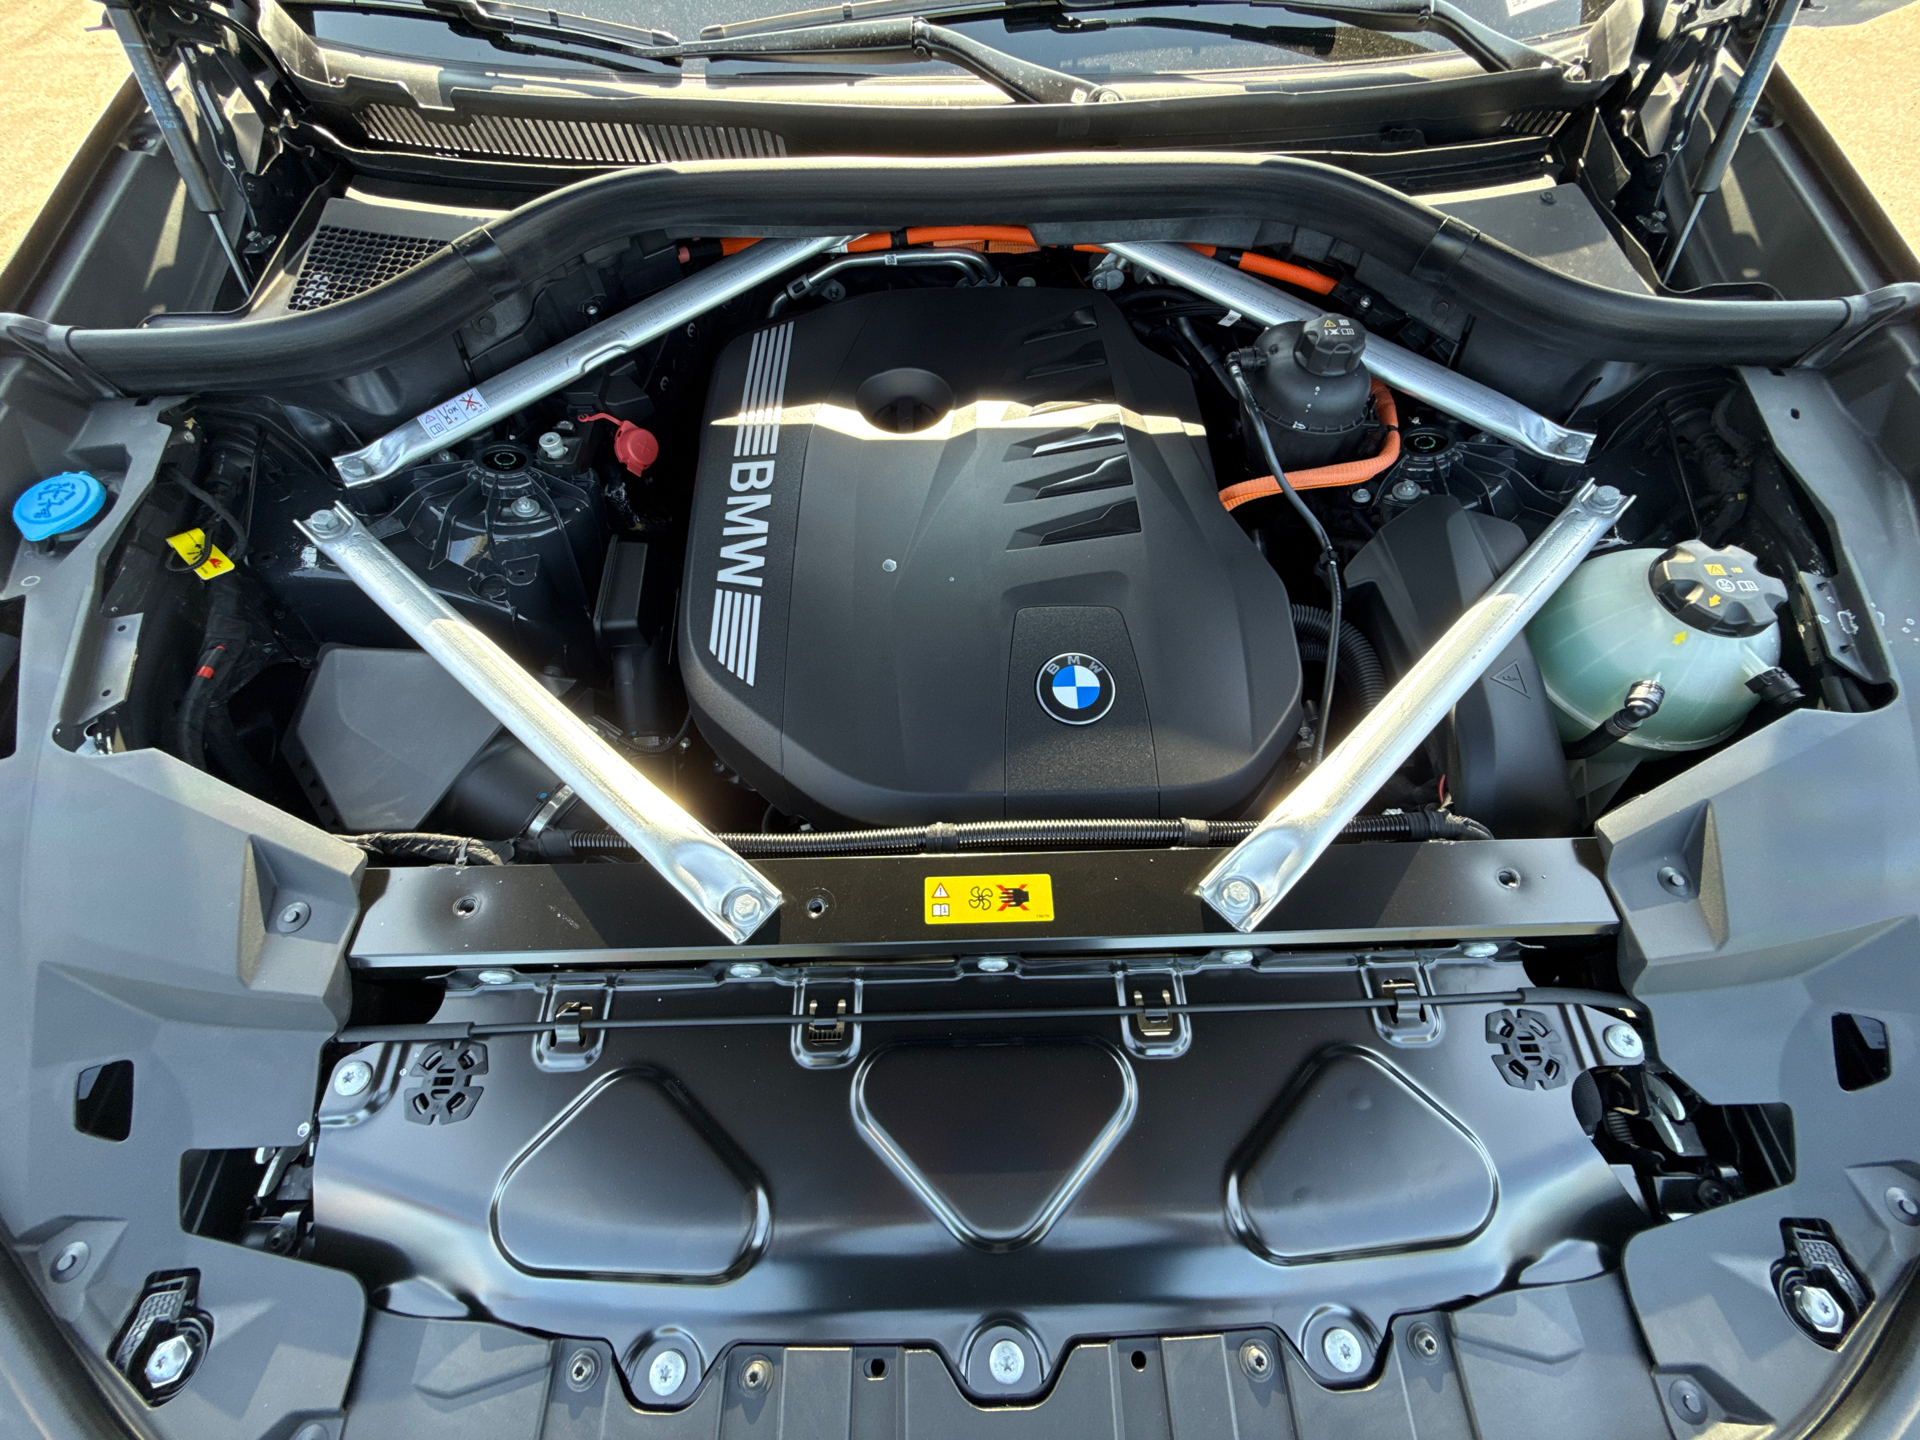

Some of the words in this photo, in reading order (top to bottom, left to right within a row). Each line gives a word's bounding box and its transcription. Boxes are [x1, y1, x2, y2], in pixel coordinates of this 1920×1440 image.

[447, 405, 459, 414] OK
[716, 460, 775, 587] BMW
[1046, 655, 1103, 675] BMW
